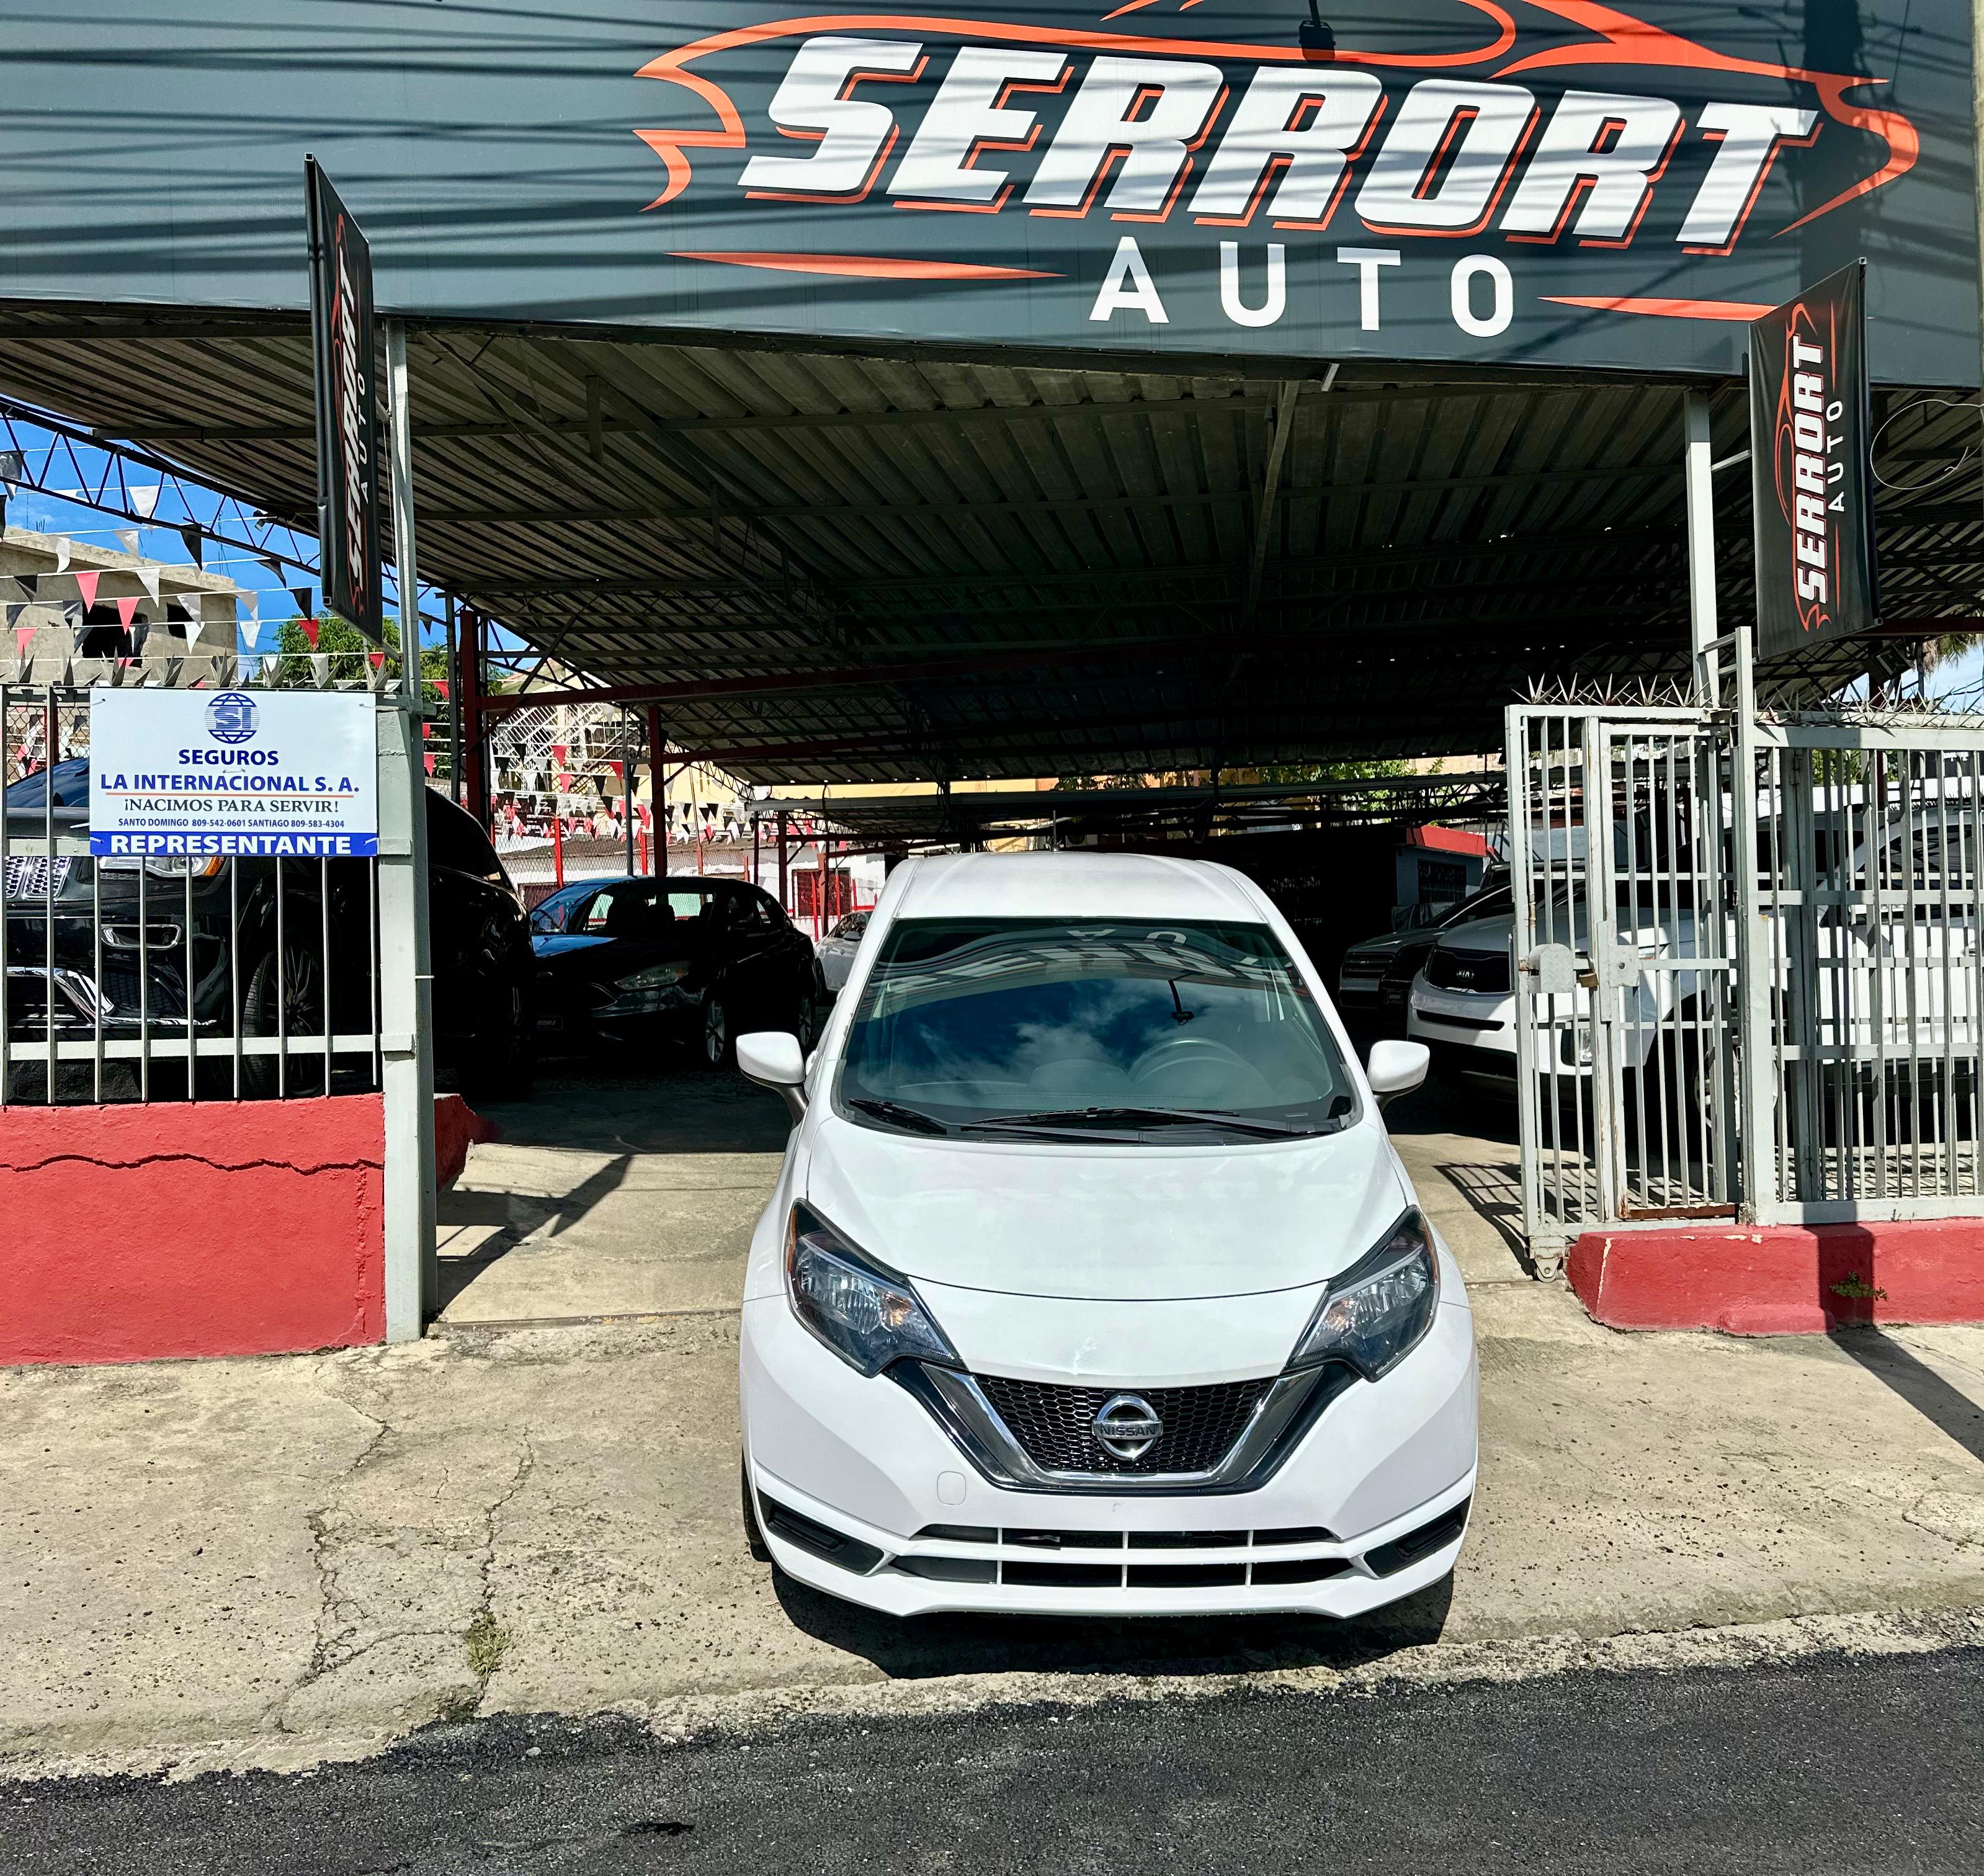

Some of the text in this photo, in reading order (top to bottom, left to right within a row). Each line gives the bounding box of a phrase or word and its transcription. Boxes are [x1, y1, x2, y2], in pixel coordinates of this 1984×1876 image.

[737, 35, 1821, 252] SERRORT
[1089, 236, 1514, 338] AUTO
[358, 372, 369, 504] AUTO
[1826, 400, 1845, 512] AUTO
[1793, 333, 1828, 605] SERRORT
[179, 749, 279, 766] SEGUROS
[101, 774, 359, 792] LA INTERNACIONAL S. A.
[125, 798, 339, 813] ¡NACIMOS PARA SERVIR!
[118, 818, 146, 826] SANTO
[148, 818, 189, 826] DOMINGO
[192, 819, 246, 827] 809-542-0601
[248, 820, 289, 828] SANTIAGO
[111, 835, 351, 854] REPRESENTANTE
[1099, 1424, 1156, 1436] NISSAN
